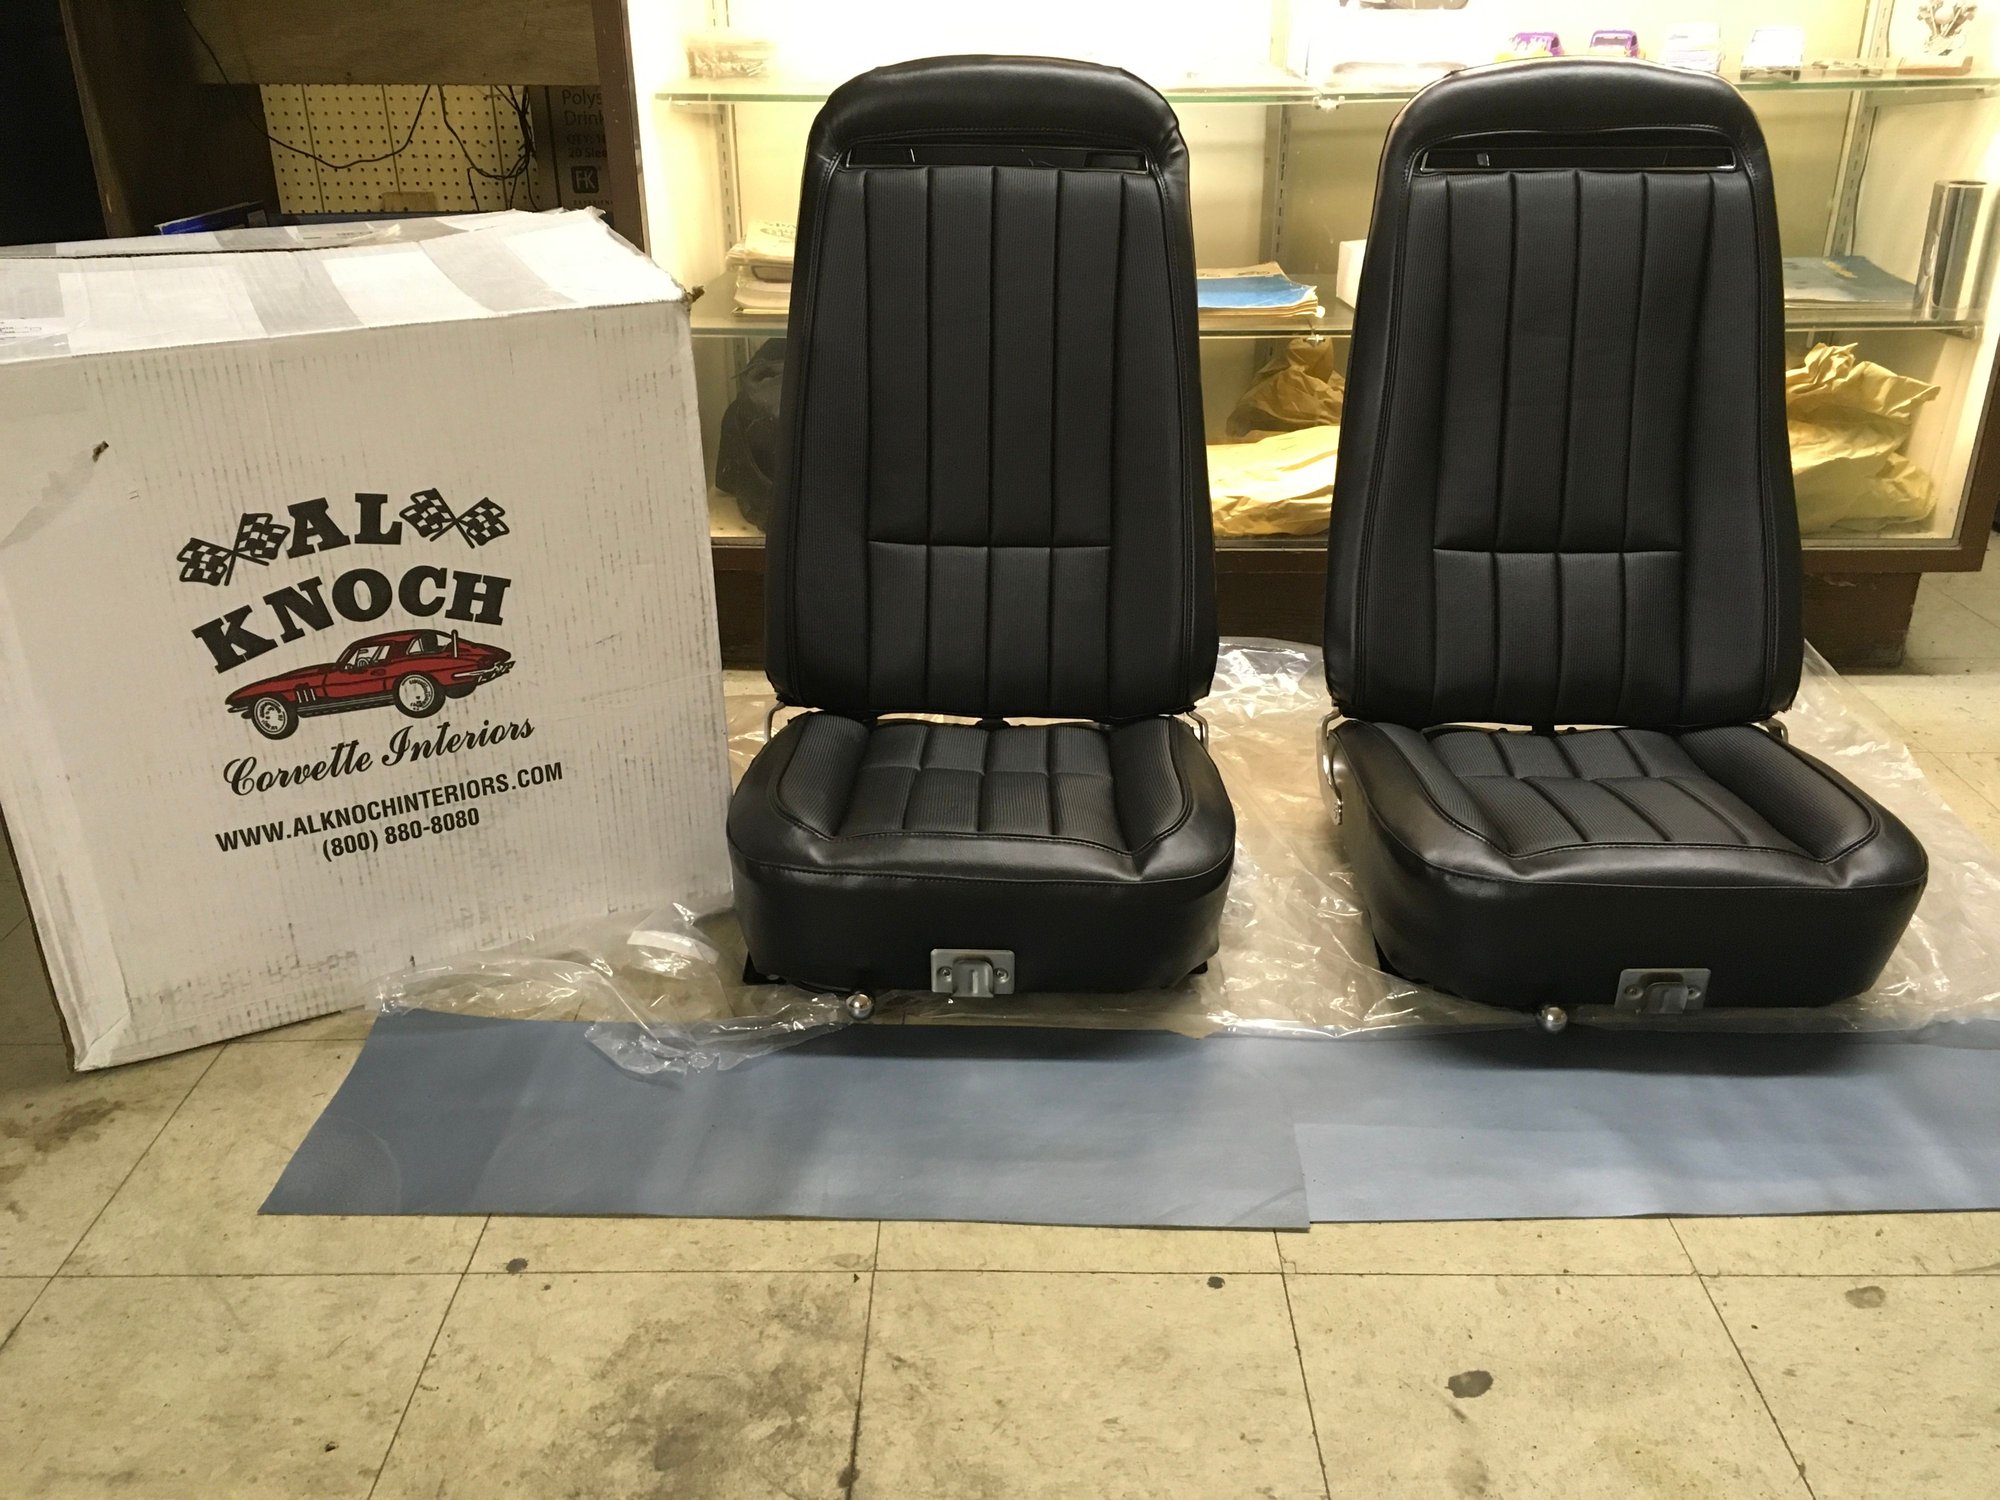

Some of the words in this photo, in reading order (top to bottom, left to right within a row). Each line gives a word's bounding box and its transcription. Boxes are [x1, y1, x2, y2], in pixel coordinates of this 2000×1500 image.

[287, 493, 402, 560] AL
[192, 565, 512, 674] KNOCH
[224, 739, 373, 796] Corvette
[381, 717, 535, 767] Interiors
[215, 761, 563, 852] WWW.ALKNOCHINTERIORS.COM
[322, 829, 379, 862] (800)
[384, 807, 480, 844] 880-8080
